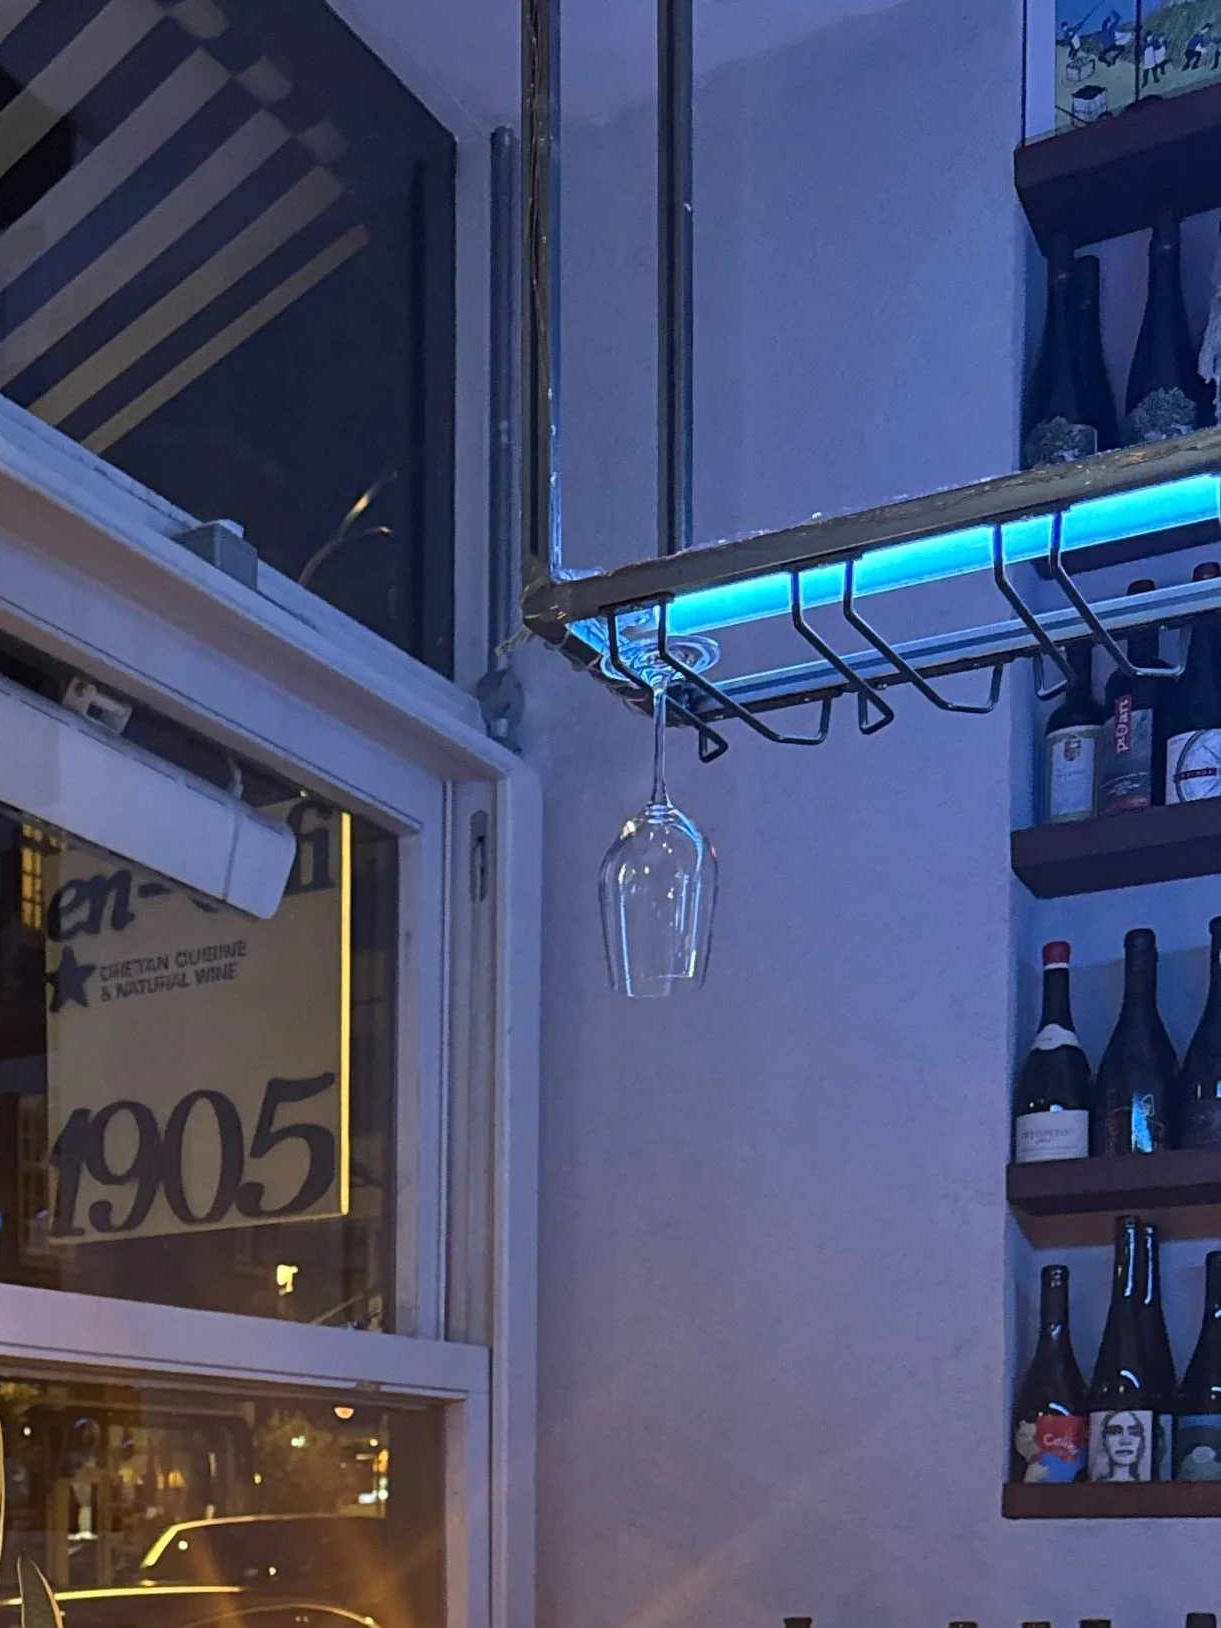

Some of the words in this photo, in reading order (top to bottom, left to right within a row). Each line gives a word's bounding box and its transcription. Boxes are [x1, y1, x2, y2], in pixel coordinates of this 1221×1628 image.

[99, 955, 168, 982] CRETAN
[175, 940, 247, 967] CUISINE
[101, 987, 111, 1002] &
[116, 973, 190, 999] NATURAL
[195, 963, 238, 984] WINE
[49, 1073, 335, 1237] 1905
